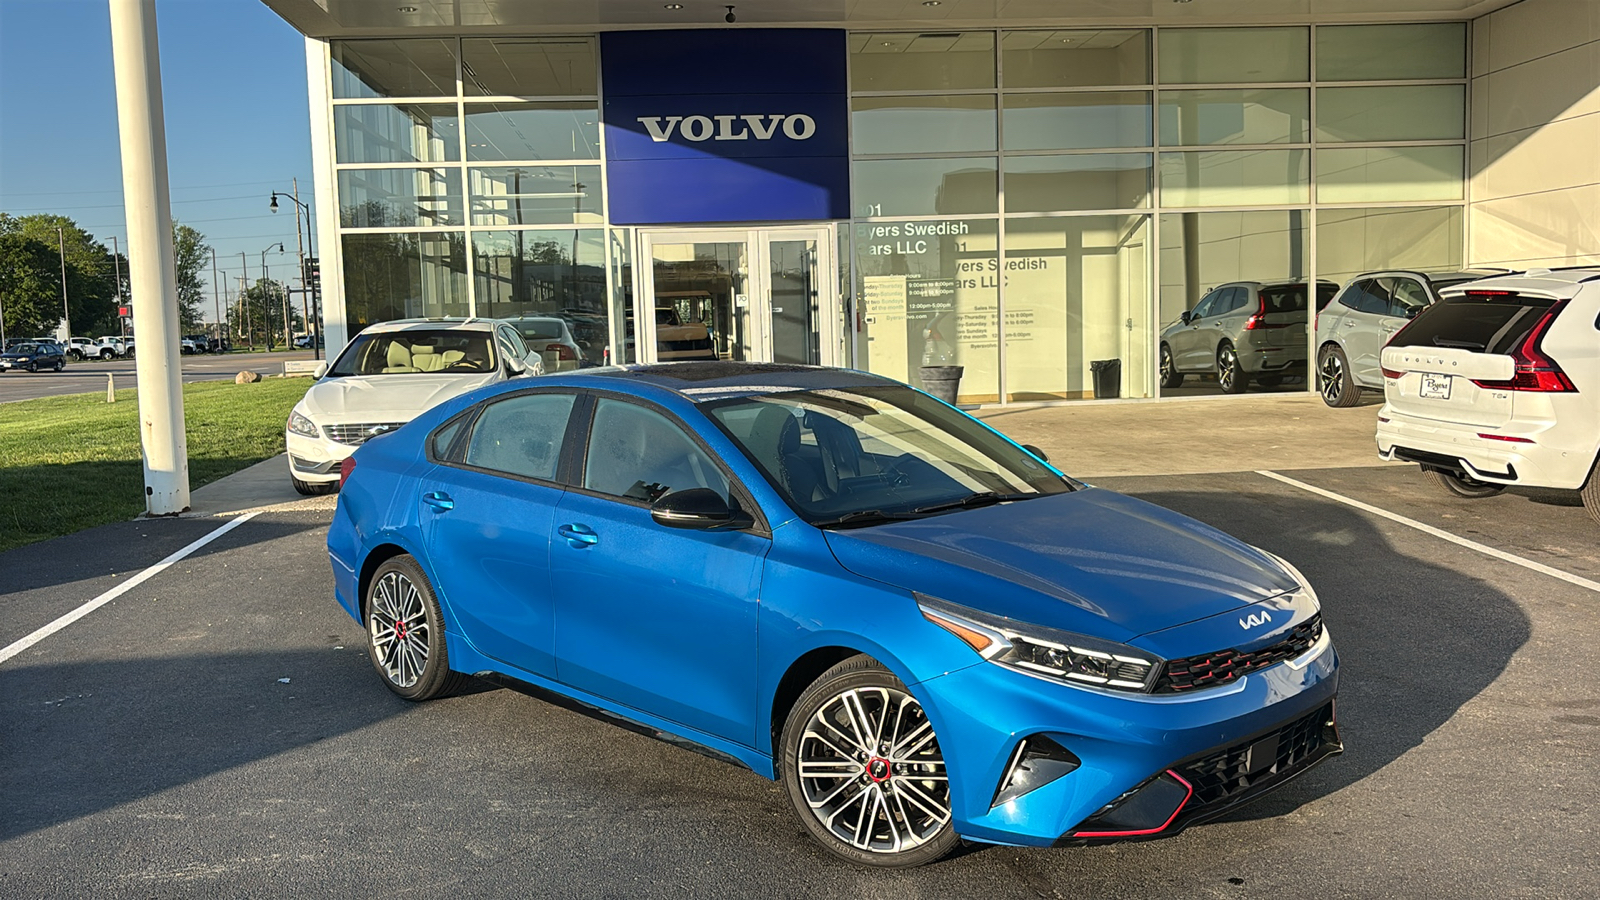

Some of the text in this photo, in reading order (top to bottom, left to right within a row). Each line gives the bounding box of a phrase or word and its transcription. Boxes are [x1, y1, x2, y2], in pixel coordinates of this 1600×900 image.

[636, 113, 816, 142] VOLVO
[904, 221, 968, 236] Swedish
[896, 240, 927, 254] LLC
[955, 259, 983, 274] yers
[955, 278, 976, 289] ars
[1405, 357, 1458, 366] VOLVO
